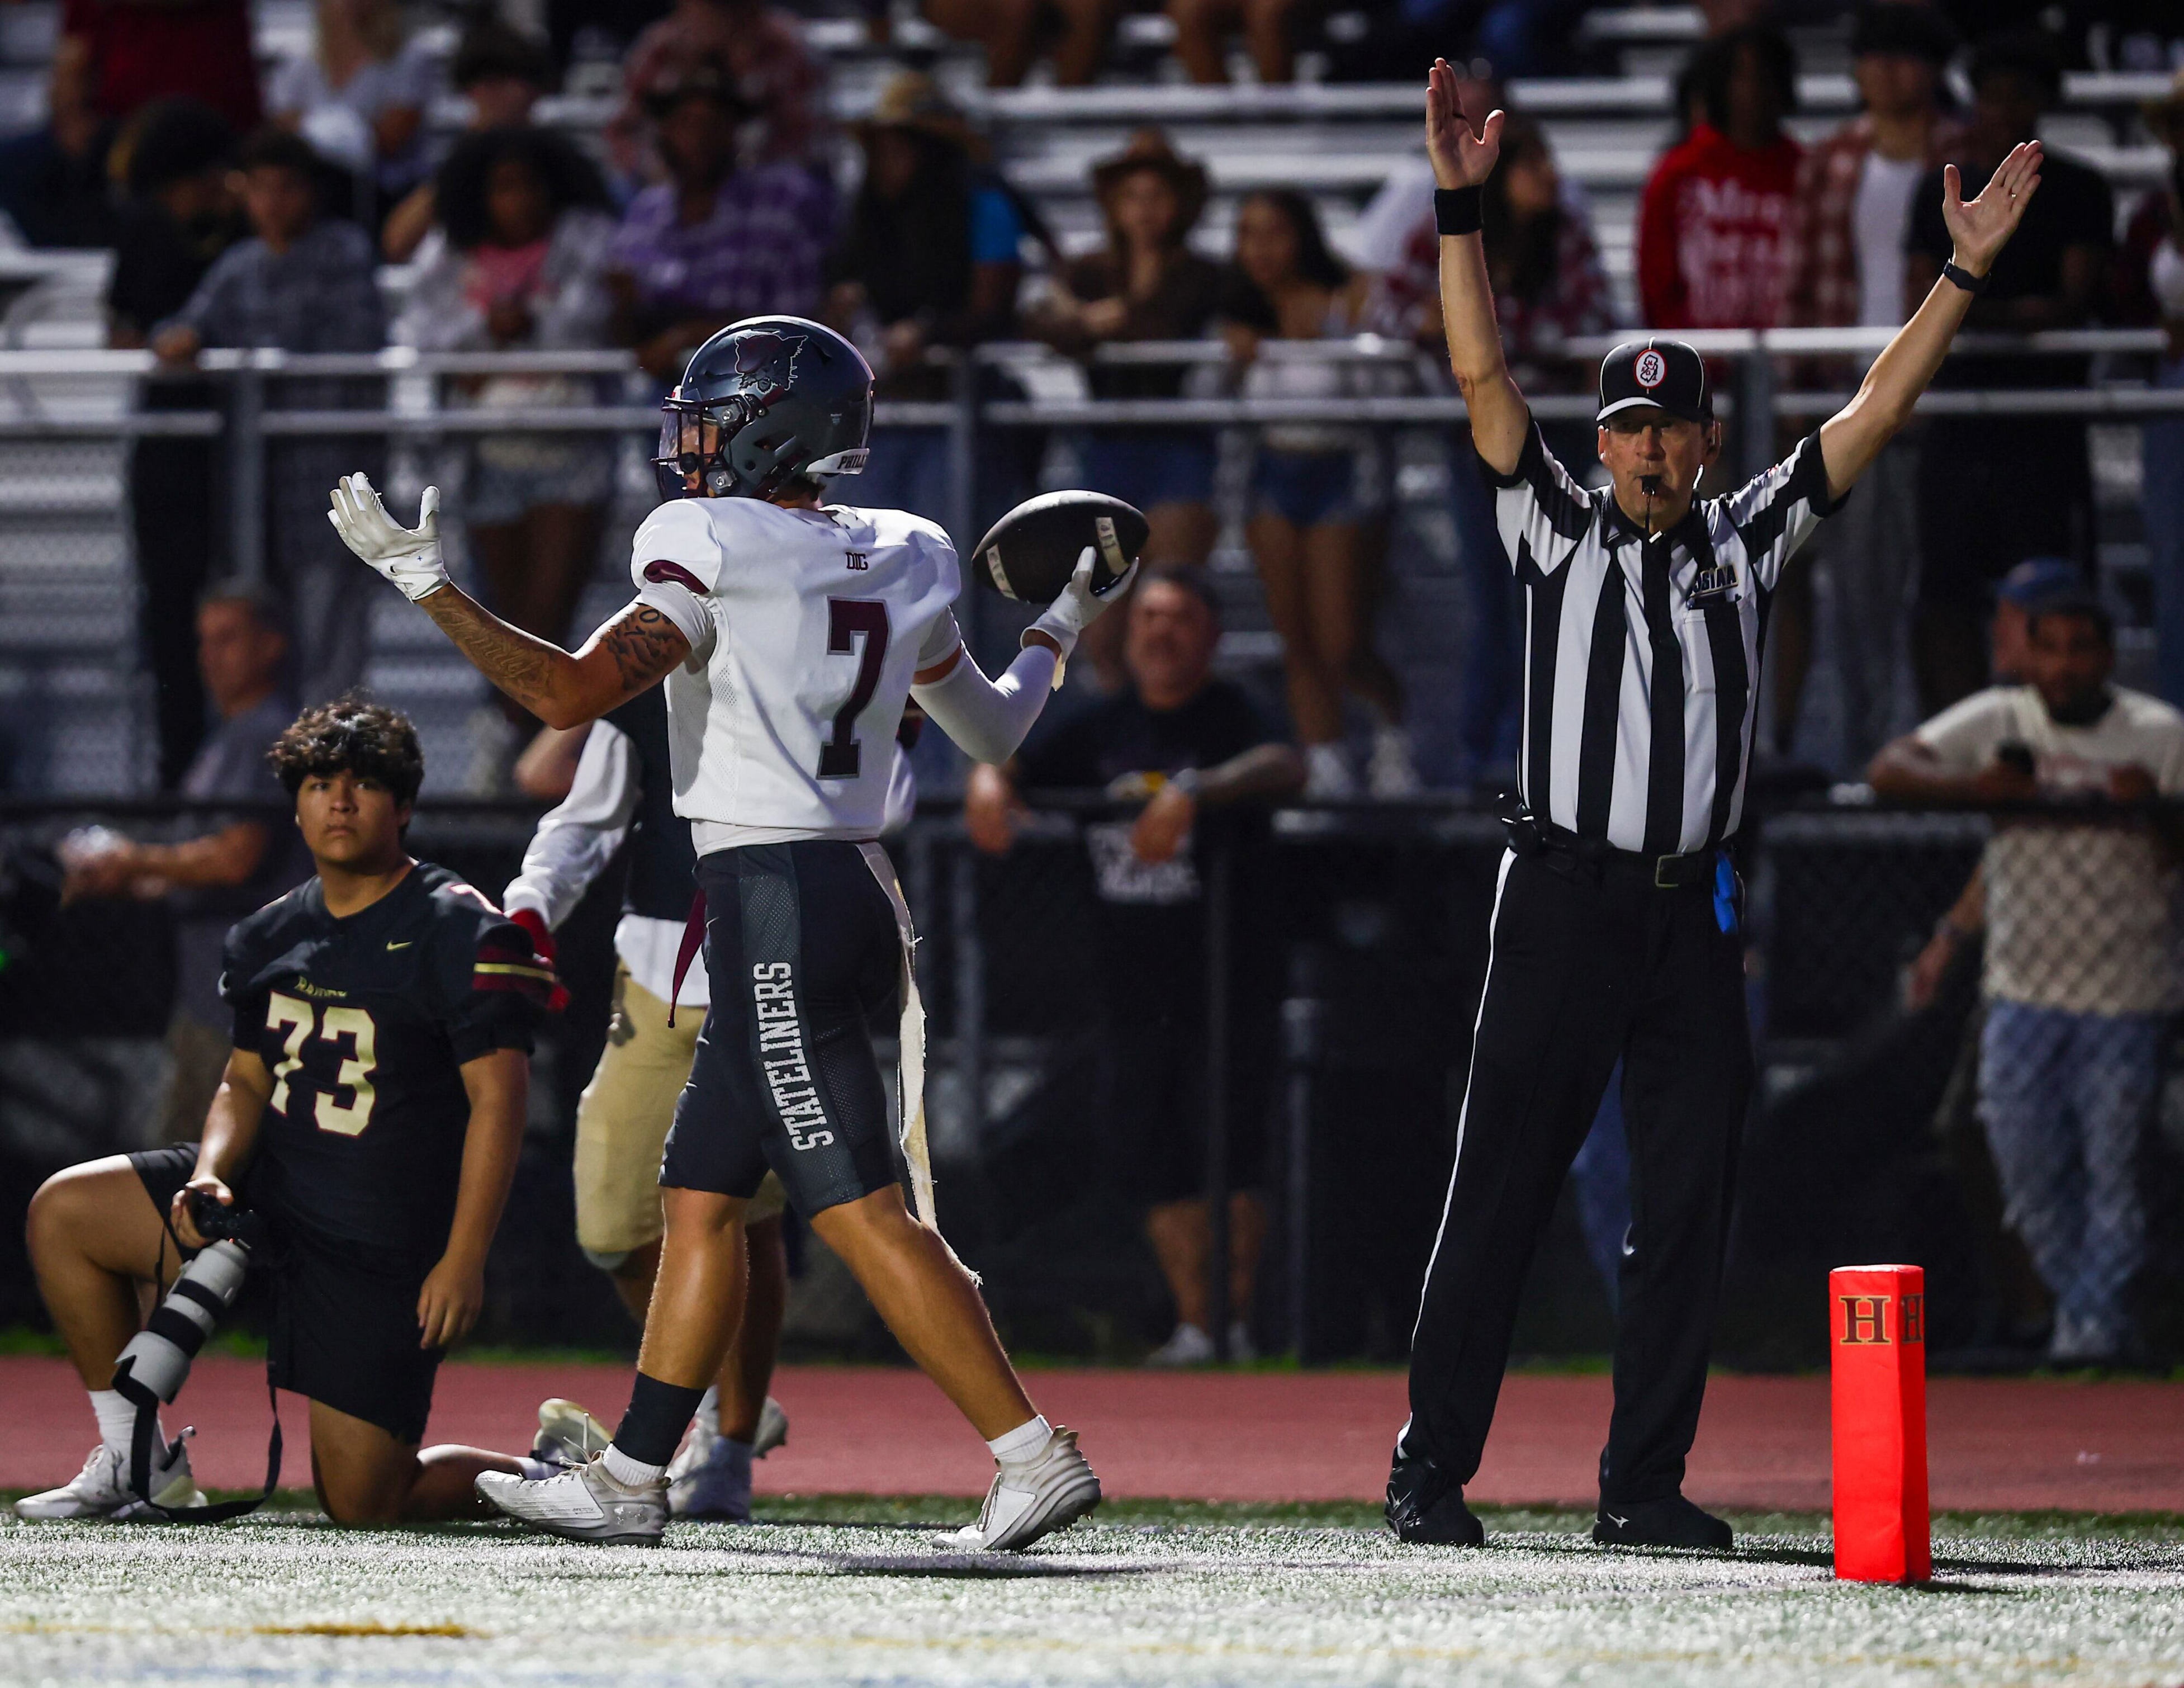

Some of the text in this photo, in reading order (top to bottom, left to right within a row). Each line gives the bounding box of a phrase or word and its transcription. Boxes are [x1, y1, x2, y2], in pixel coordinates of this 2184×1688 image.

[846, 552, 868, 570] DIG
[816, 595, 892, 780] 7
[264, 989, 378, 1139] 73
[753, 961, 835, 1151] STATELINERS
[1839, 1295, 1892, 1345] H
[1901, 1293, 1923, 1345] H
